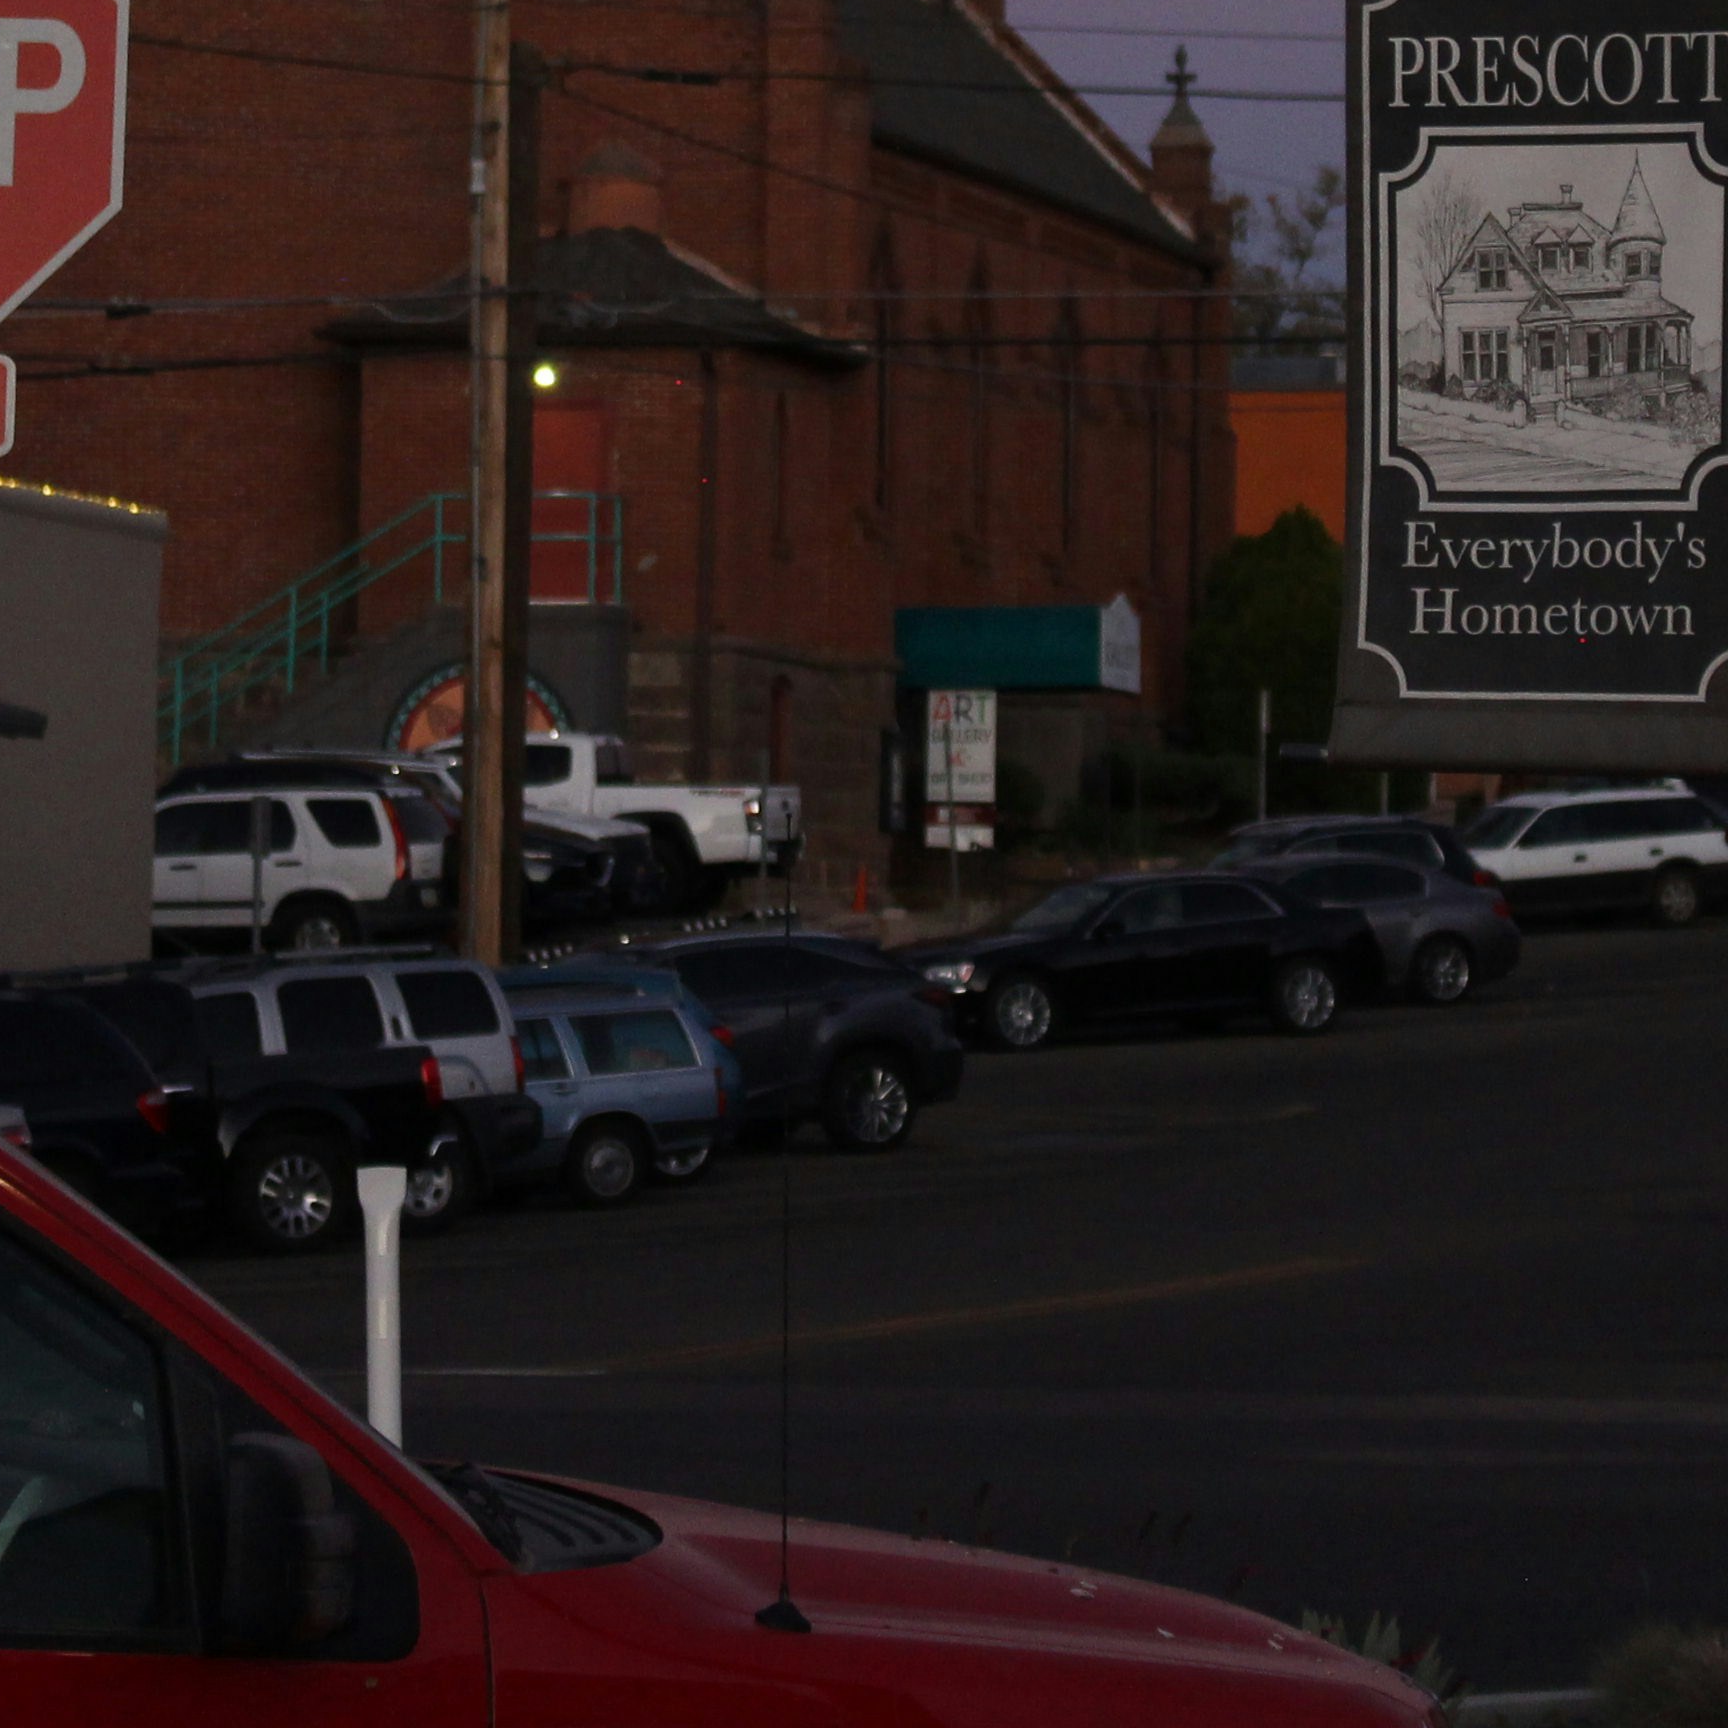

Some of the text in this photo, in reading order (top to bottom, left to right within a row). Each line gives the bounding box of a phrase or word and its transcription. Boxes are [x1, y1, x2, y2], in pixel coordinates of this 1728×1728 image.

[1401, 521, 1707, 584] Everybody's
[1408, 587, 1696, 636] Hometown
[933, 694, 989, 723] ART
